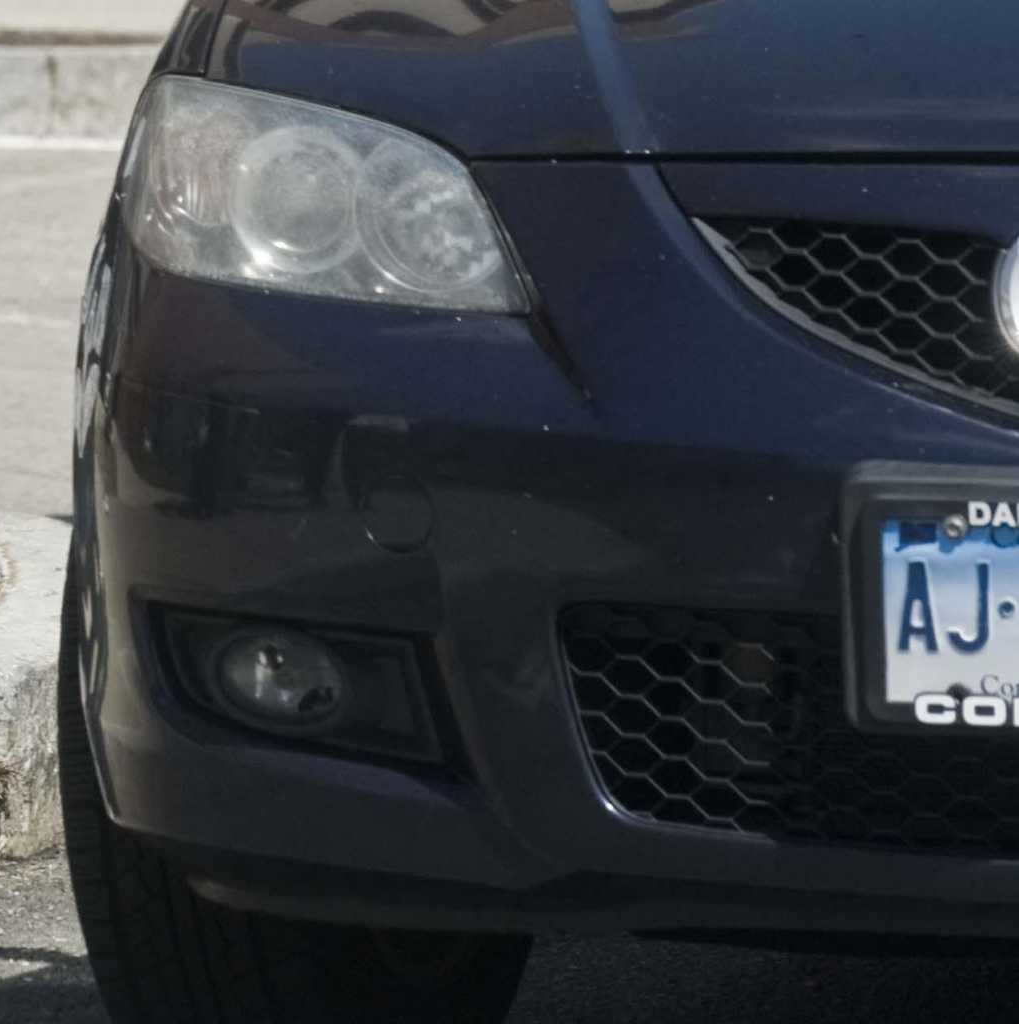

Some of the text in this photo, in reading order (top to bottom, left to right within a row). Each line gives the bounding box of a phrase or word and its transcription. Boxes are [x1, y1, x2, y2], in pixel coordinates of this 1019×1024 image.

[967, 501, 1019, 527] DA
[980, 674, 1019, 699] Co
[914, 693, 1019, 727] CO
